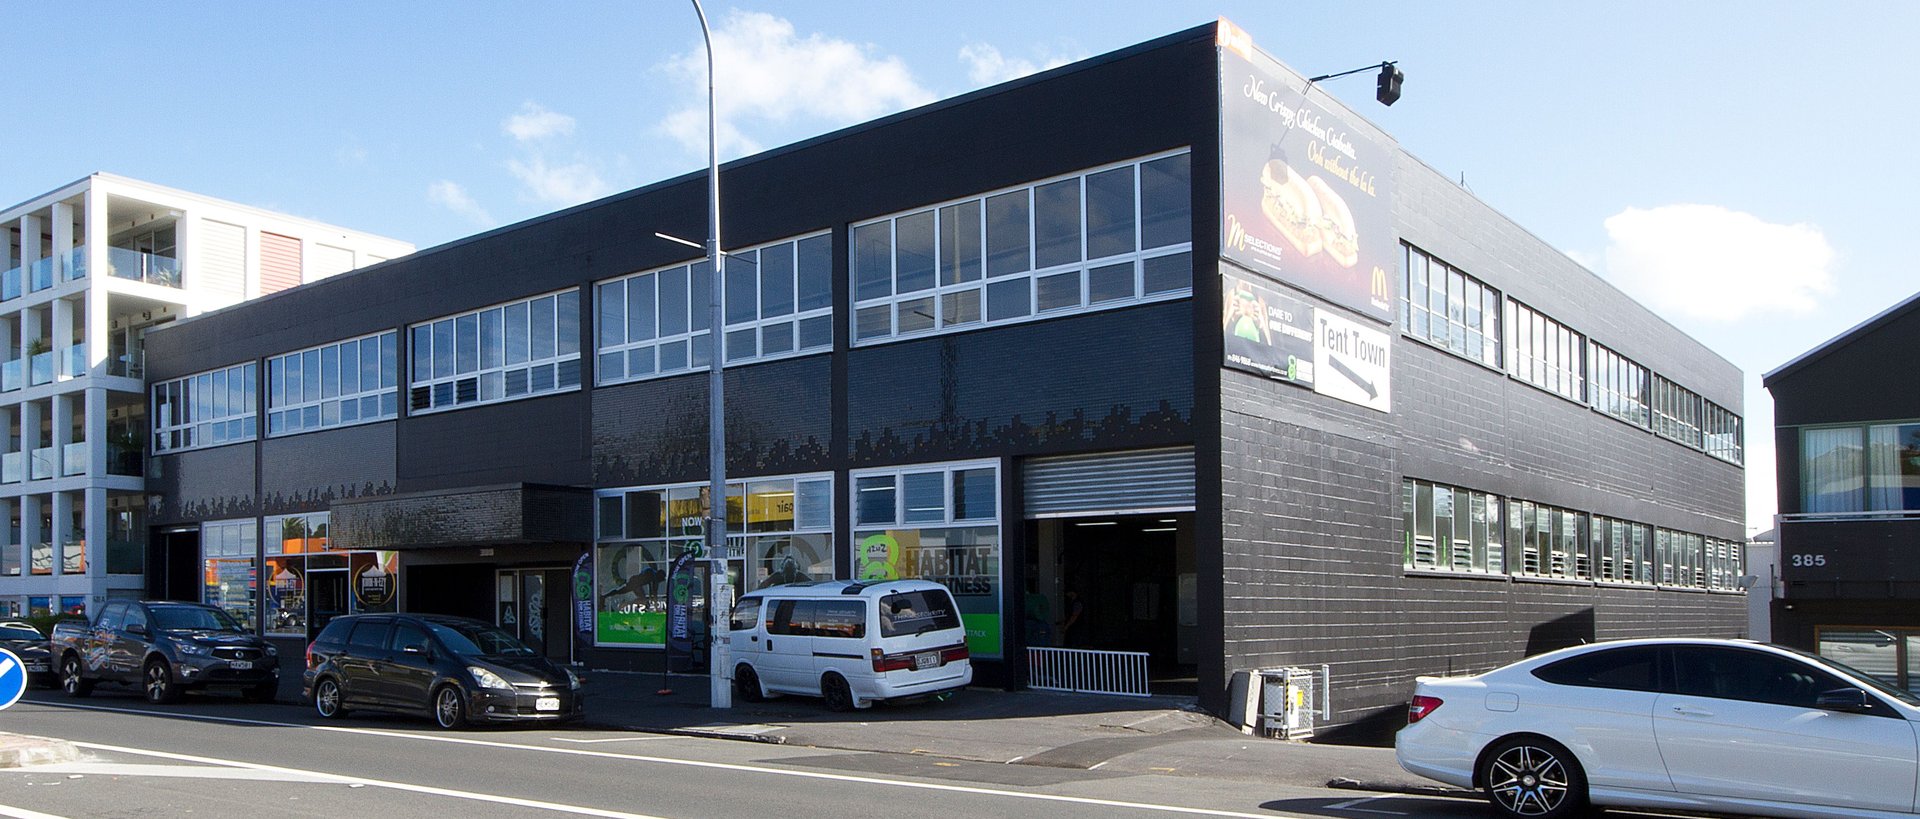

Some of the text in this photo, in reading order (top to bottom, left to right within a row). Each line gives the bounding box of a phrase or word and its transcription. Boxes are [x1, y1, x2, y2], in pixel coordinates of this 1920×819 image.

[1244, 74, 1267, 106] New
[1320, 318, 1386, 368] Tent Town
[682, 516, 702, 527] NOW
[906, 548, 991, 576] HABITAT
[1792, 554, 1826, 567] 385
[935, 575, 991, 593] TNESS
[584, 601, 592, 632] HABITAT
[679, 605, 687, 639] HABITAT
